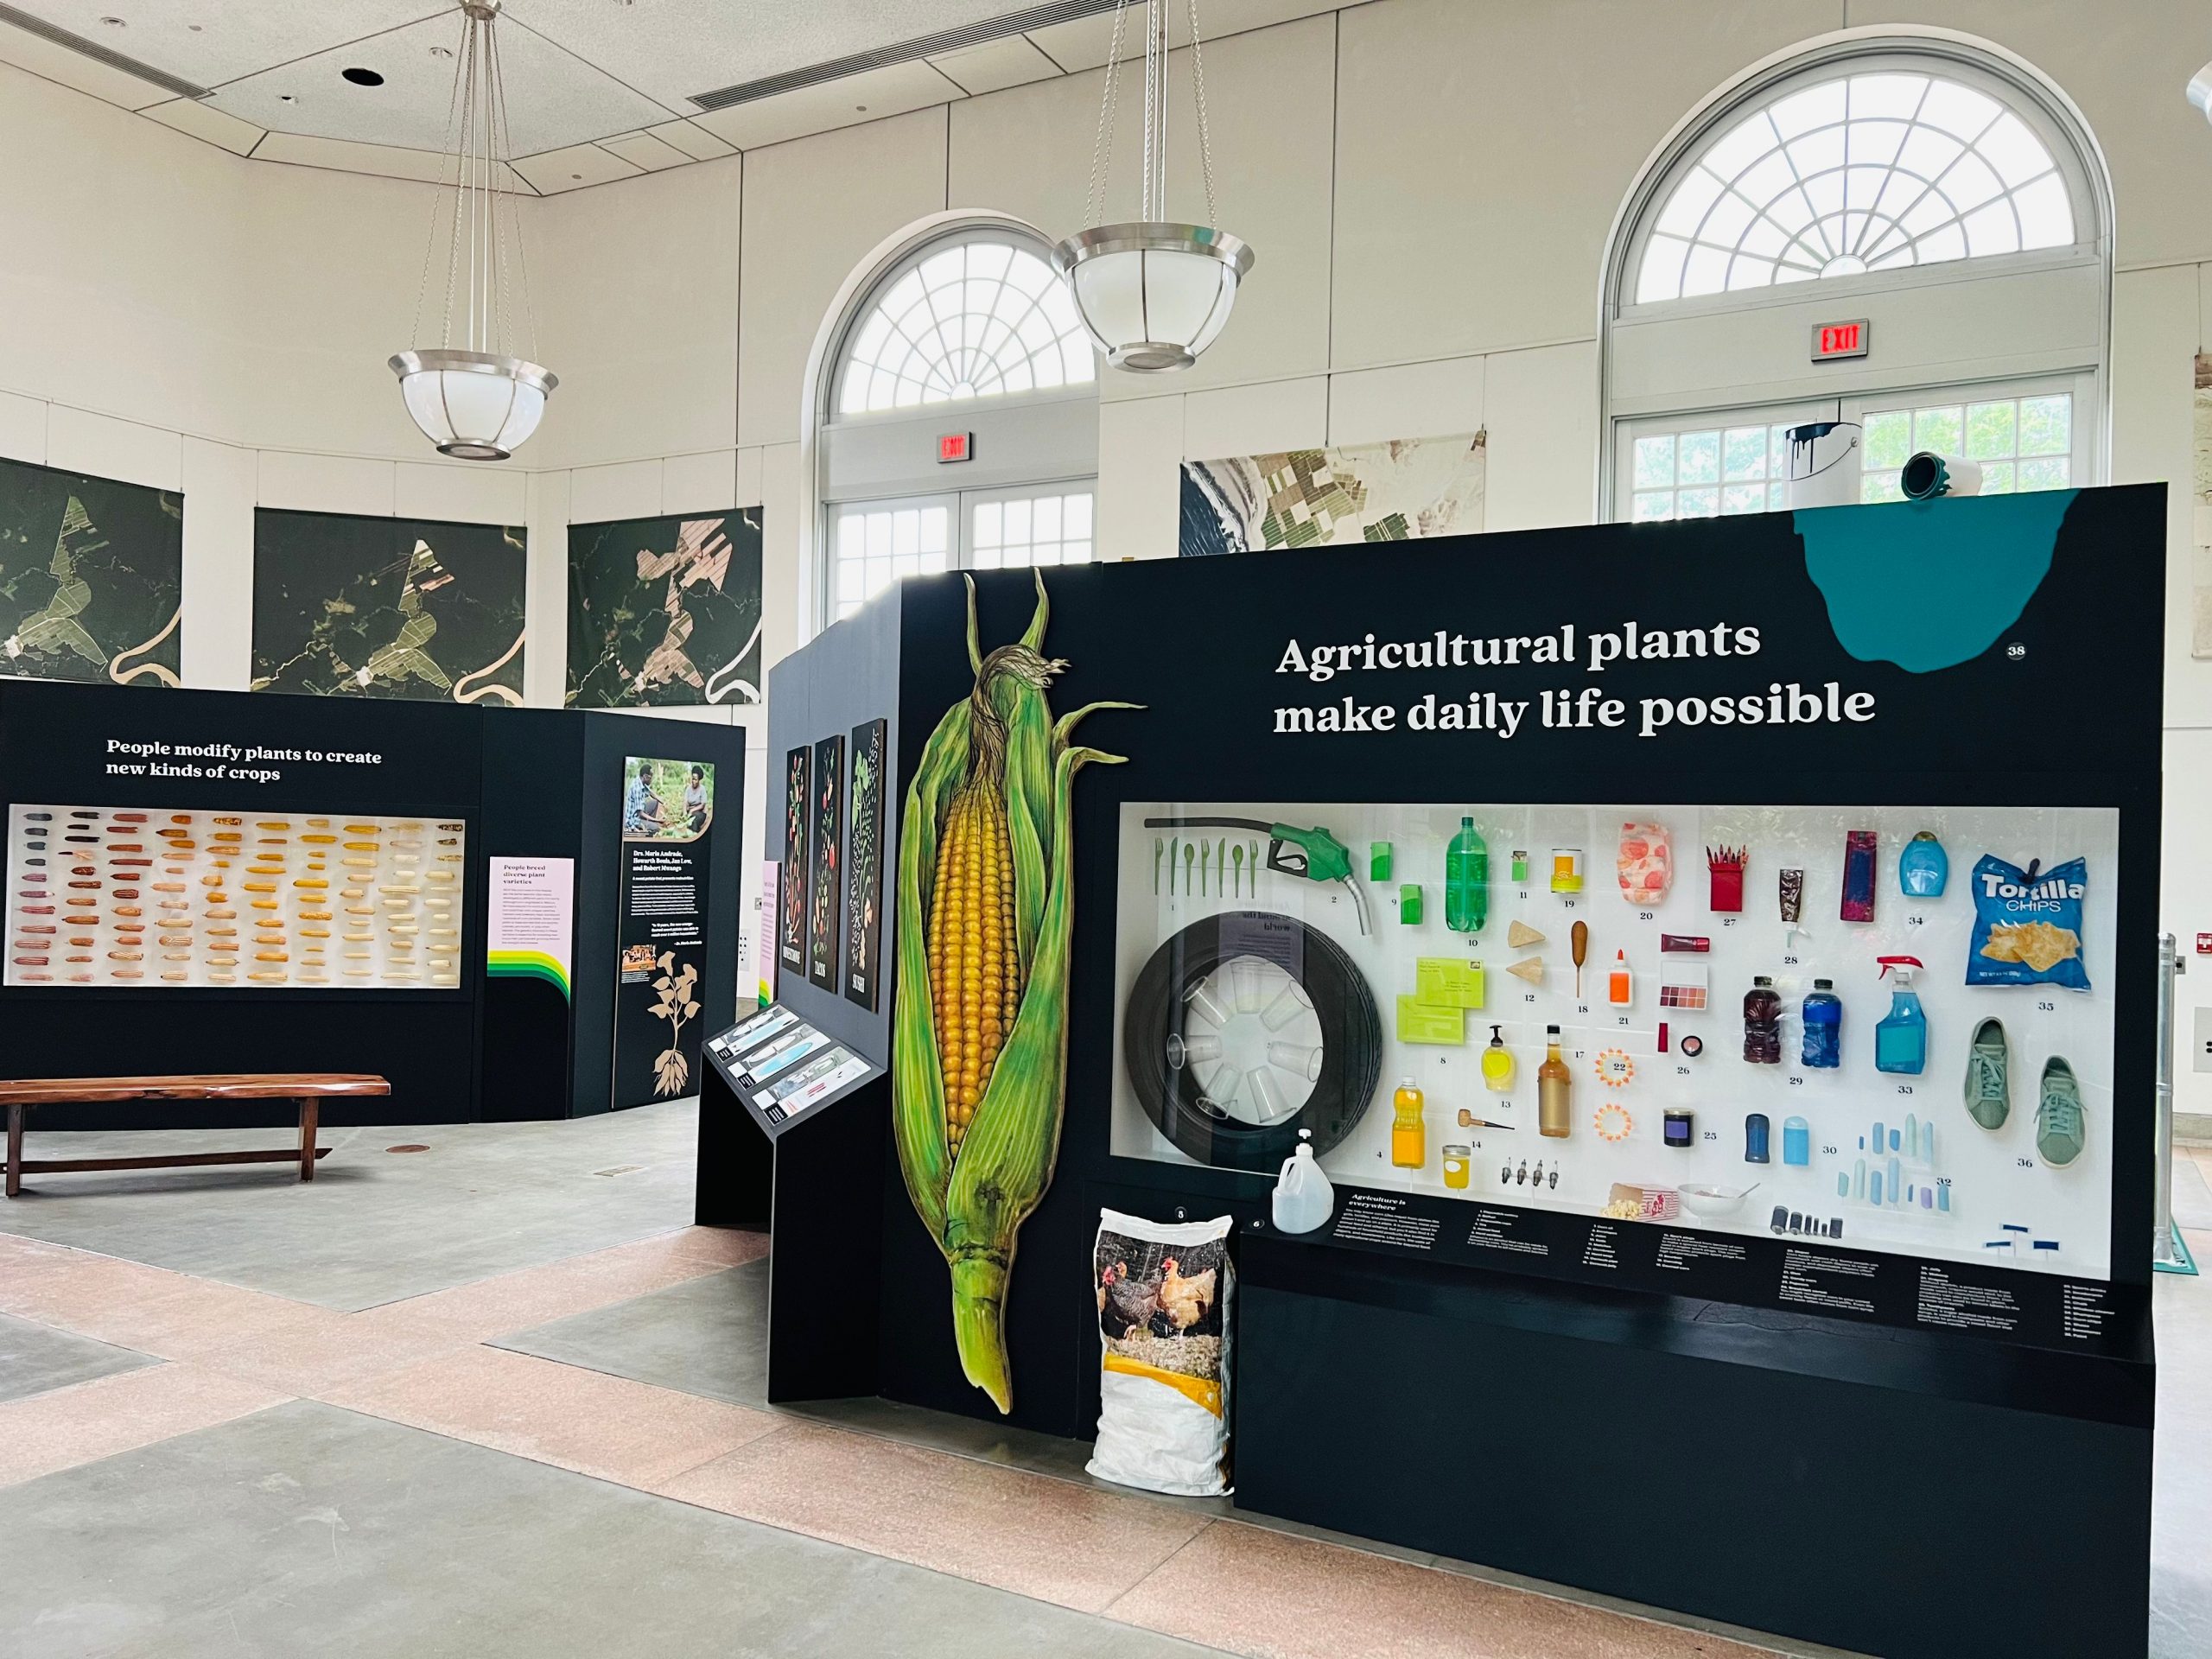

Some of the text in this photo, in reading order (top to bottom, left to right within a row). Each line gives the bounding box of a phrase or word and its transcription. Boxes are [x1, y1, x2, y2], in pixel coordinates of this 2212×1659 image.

[1821, 324, 1860, 354] EXIT
[940, 434, 966, 460] EXIT
[1275, 621, 1761, 682] Agricultural plants
[2007, 645, 2026, 657] 38
[1273, 682, 1876, 738] make daily life possible
[106, 740, 382, 764] People modify plants to create
[105, 762, 281, 783] new kinds of crops
[1981, 874, 2085, 900] Tortilla
[1520, 891, 1528, 899] 11
[1391, 898, 1397, 907] 9
[1565, 899, 1575, 908] 19
[2005, 900, 2062, 912] CHIPS
[1640, 912, 1653, 920] 20
[1909, 917, 1923, 925] 34
[1784, 956, 1798, 964] 28
[814, 961, 826, 978] TACOS
[852, 974, 865, 994] SUSHI
[1579, 1005, 1588, 1014] 18
[2038, 1001, 2054, 1012] 35
[1613, 1063, 1627, 1071] 22
[1677, 1066, 1690, 1075] 26
[1789, 1077, 1803, 1085] 29
[1897, 1085, 1913, 1095] 33
[1501, 1100, 1511, 1109] 13
[1471, 1141, 1481, 1149] 14
[1822, 1146, 1837, 1154] 30
[2018, 1158, 2033, 1168] 36
[1936, 1177, 1952, 1187] 32
[1351, 1193, 1398, 1205] Agriculture
[1348, 1200, 1396, 1211] everywhere
